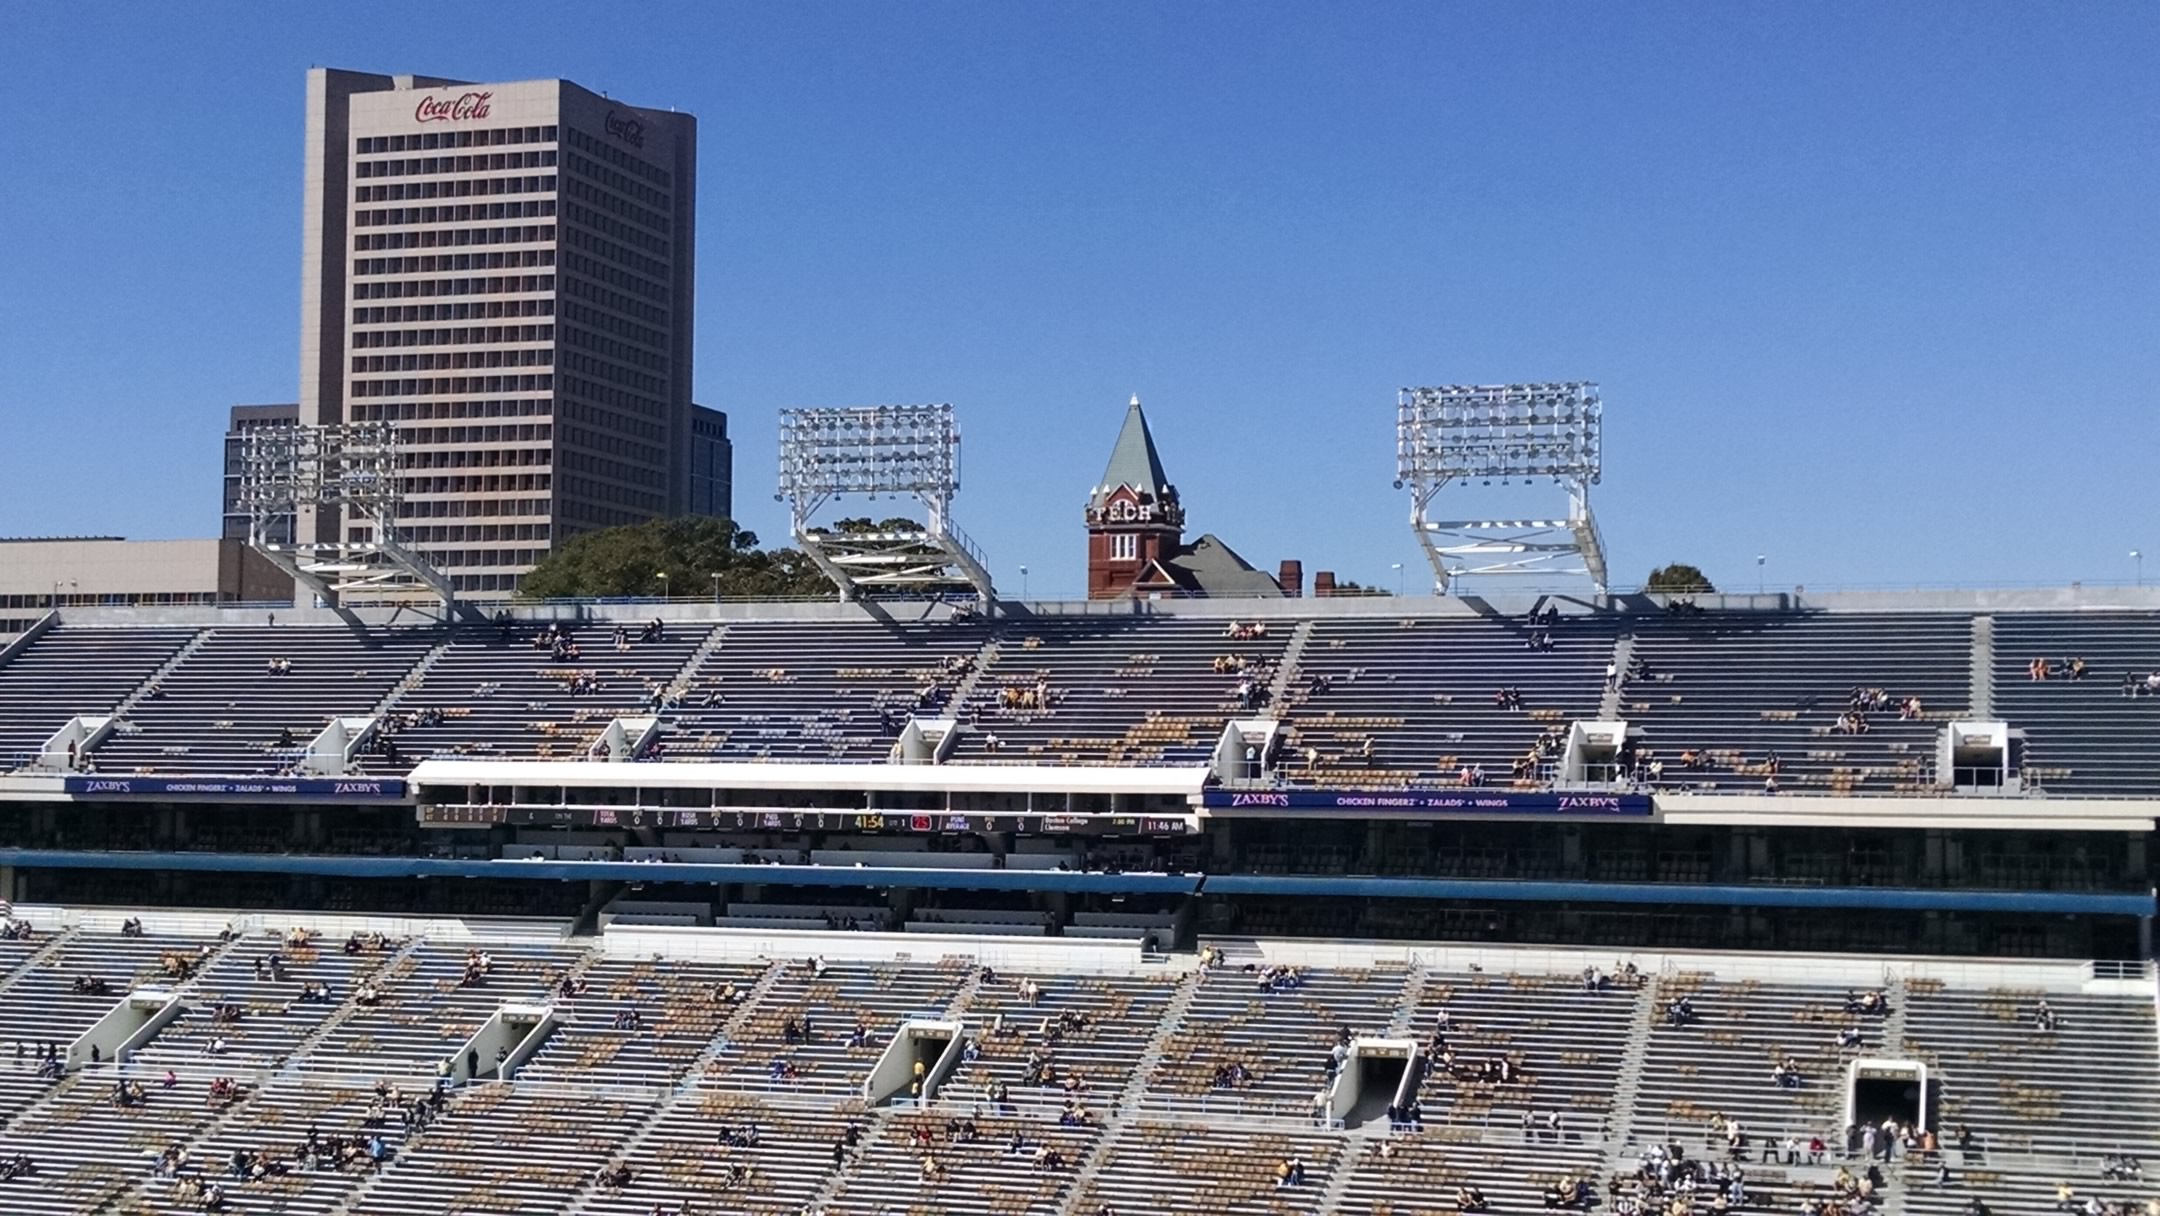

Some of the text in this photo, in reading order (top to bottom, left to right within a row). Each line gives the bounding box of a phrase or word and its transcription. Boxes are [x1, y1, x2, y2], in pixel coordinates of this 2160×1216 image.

[1093, 505, 1152, 521] TECH
[86, 781, 130, 792] ZAXBY'S
[335, 783, 381, 794] ZAXBY'S
[1232, 793, 1289, 806] ZAXBY'S
[1336, 797, 1375, 806] CHICKEN
[1475, 799, 1508, 807] WINGS
[1557, 797, 1620, 812] ZAXBY'S
[855, 815, 885, 828] 41:54
[1066, 817, 1088, 825] College
[1148, 821, 1184, 831] 11:46 AM
